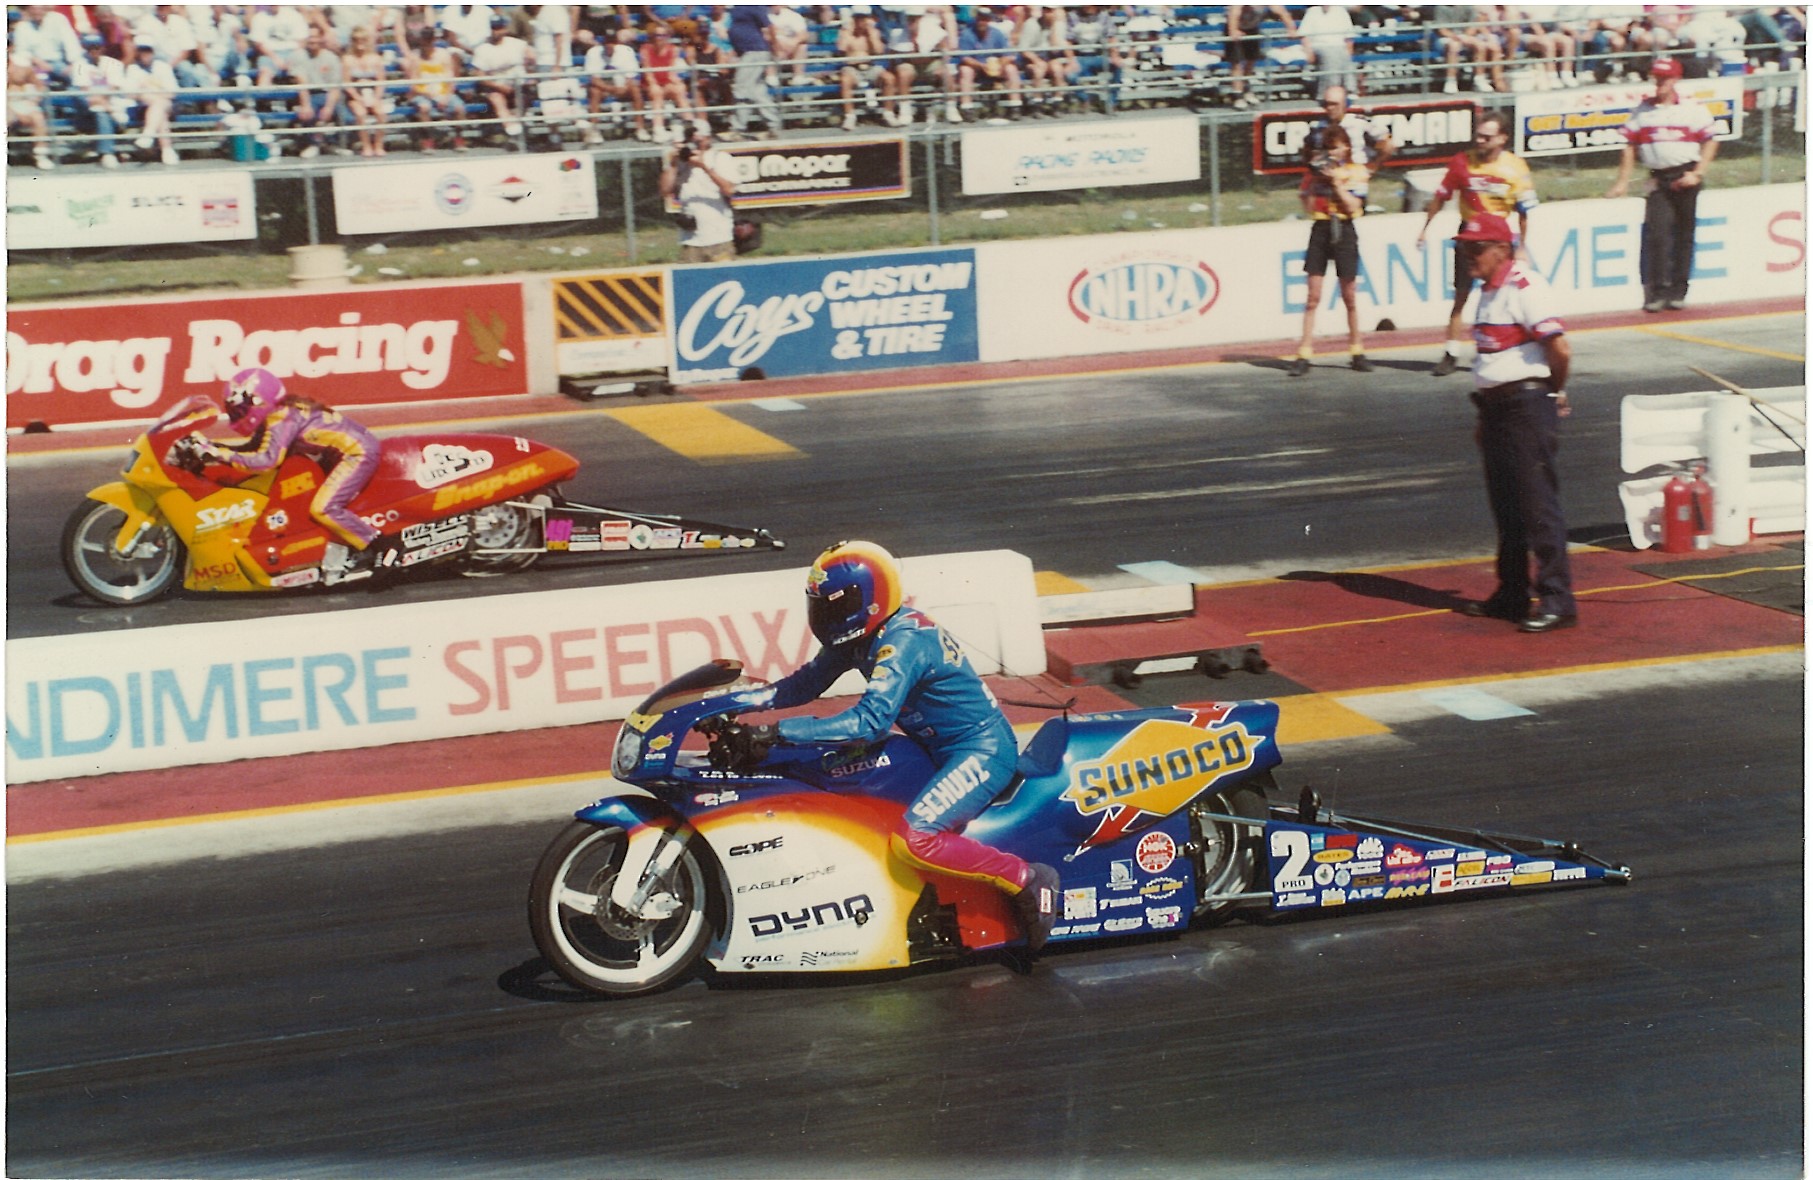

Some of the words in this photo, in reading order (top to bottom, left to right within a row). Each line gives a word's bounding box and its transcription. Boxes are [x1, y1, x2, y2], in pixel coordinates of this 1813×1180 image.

[1265, 109, 1472, 155] CRMAN
[759, 153, 851, 178] Mopar
[822, 262, 972, 300] CUSTOM
[1089, 264, 1200, 320] NHRA
[677, 280, 824, 366] Coys
[830, 295, 953, 329] WHEEL
[184, 311, 458, 390] Racing
[831, 332, 862, 361] &
[864, 324, 946, 355] TIRE
[193, 561, 236, 580] MSD
[443, 607, 820, 716] SPEEDW
[831, 755, 891, 778] SUZUKI
[1078, 730, 1247, 806] SUNOCO
[912, 755, 990, 823] SCHULTZ
[737, 877, 791, 893] EAGLE
[805, 865, 836, 881] ONE
[1270, 830, 1314, 893] 2
[1282, 879, 1306, 889] PRO
[1348, 887, 1384, 900] APE
[740, 954, 784, 963] TRAC
